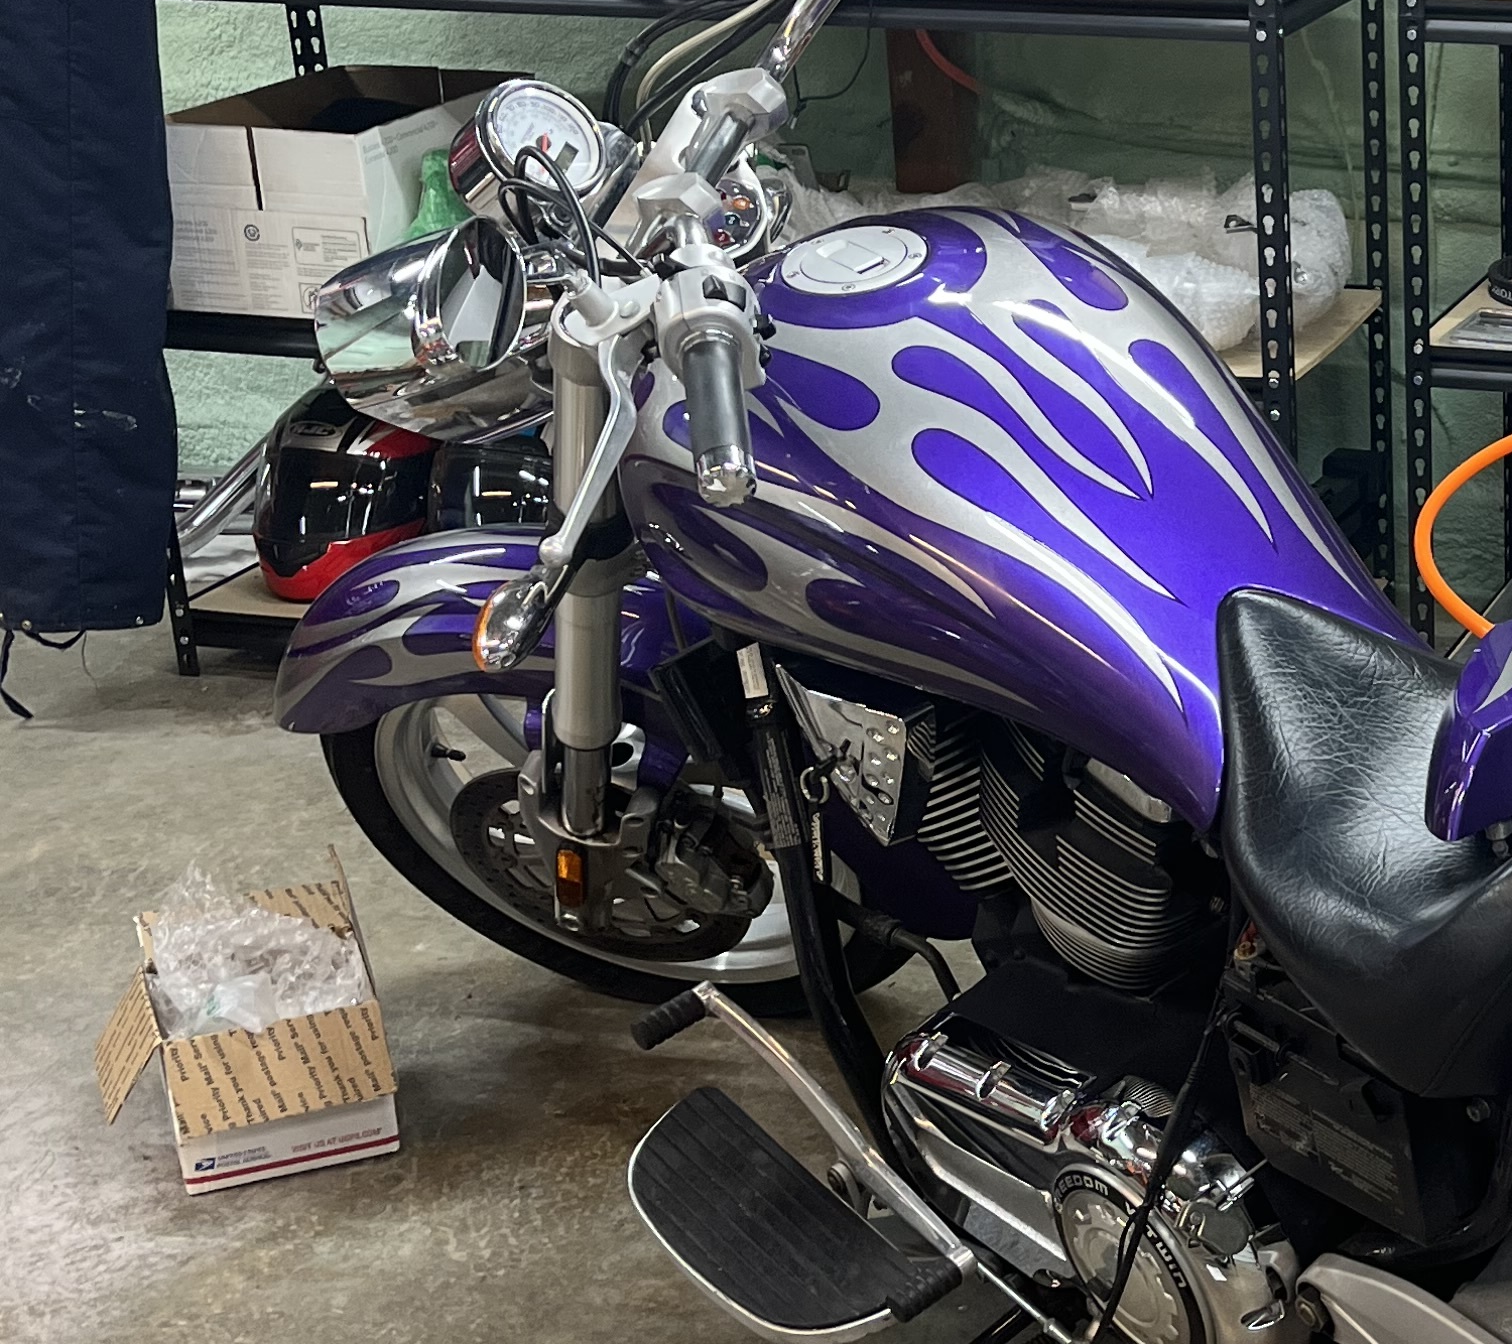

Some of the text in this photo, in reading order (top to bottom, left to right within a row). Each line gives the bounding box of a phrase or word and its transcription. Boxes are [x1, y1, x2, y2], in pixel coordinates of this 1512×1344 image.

[360, 1007, 379, 1042] Priority
[266, 1026, 286, 1061] Priority
[318, 1041, 329, 1057] for
[349, 1030, 372, 1068] postage
[222, 1060, 233, 1076] for
[255, 1049, 277, 1088] postage
[326, 1055, 340, 1075] you
[230, 1075, 243, 1095] you
[308, 1065, 328, 1101] Priority
[211, 1083, 231, 1122] Priority
